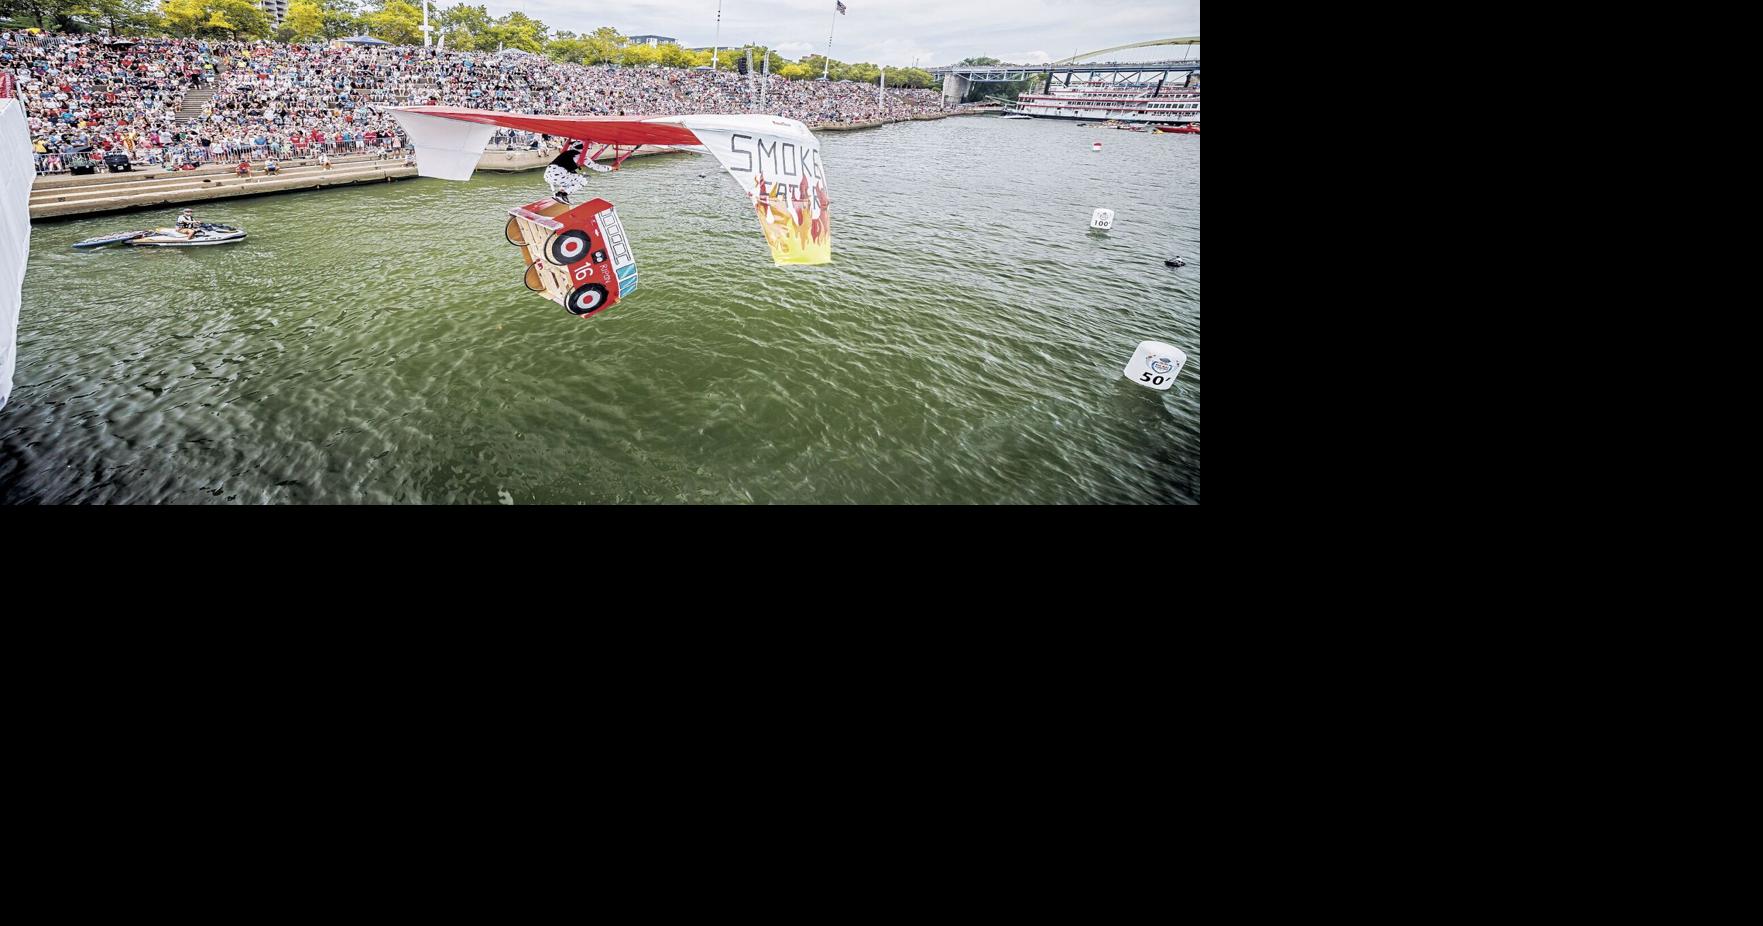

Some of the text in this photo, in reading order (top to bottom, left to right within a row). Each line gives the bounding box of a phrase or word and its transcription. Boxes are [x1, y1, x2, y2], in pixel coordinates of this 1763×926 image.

[730, 133, 821, 179] SMOKE
[760, 181, 822, 209] EATR
[574, 261, 594, 281] 16
[1139, 371, 1171, 386] 50'
